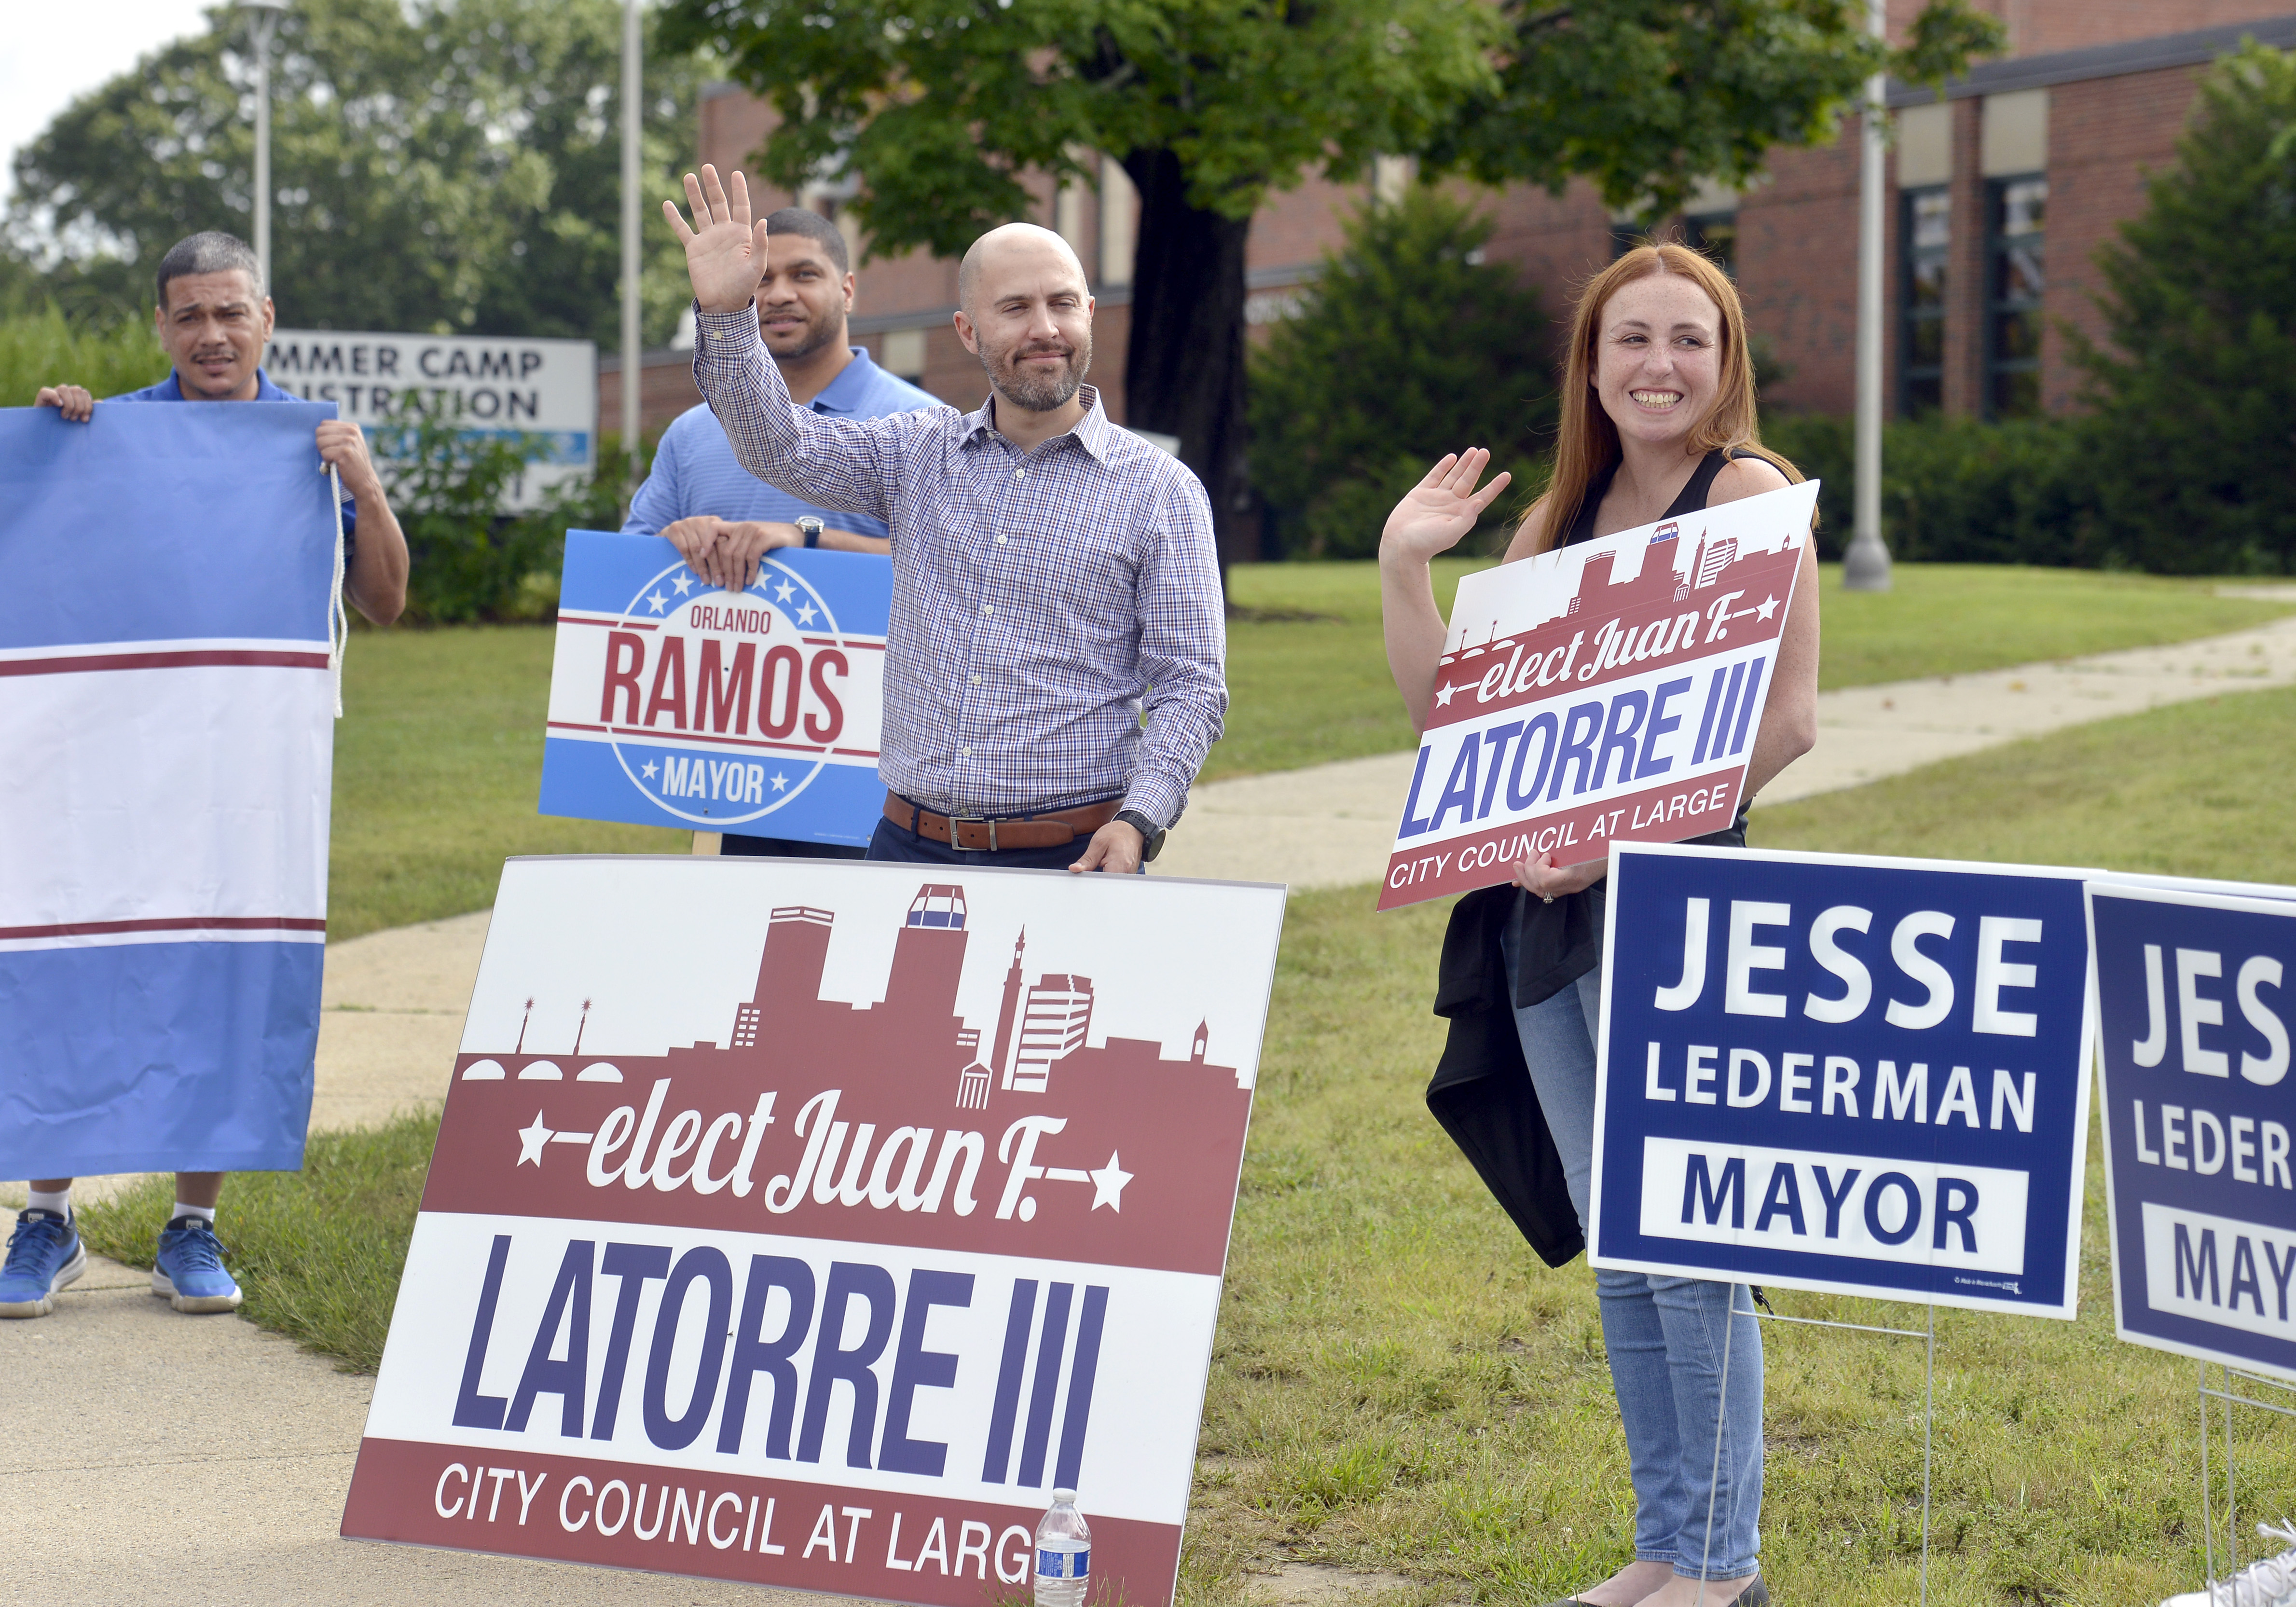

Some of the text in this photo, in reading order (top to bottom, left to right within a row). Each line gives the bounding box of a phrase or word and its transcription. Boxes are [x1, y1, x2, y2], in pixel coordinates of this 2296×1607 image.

[268, 344, 542, 381] MMER CAMP
[303, 385, 536, 420] ISTRATION
[690, 605, 771, 635] ORLANDO
[1477, 589, 1746, 703] elect Juan F.
[601, 632, 848, 743] RAMOS
[662, 756, 764, 804] MAYOR
[1397, 657, 1766, 840] LATORRE III
[1390, 783, 1729, 889] CITY COUNCIL AT LARGE
[1654, 897, 2043, 1037] JESSE
[2133, 945, 2290, 1085] JES
[1645, 1042, 2036, 1133] LEDERMAN
[587, 1078, 1068, 1222] elect Juan F.
[2134, 1100, 2292, 1189] LEDER
[1681, 1154, 1979, 1253] MAYOR
[2174, 1222, 2296, 1321] MAY
[451, 1235, 1110, 1493] LATORRE III
[435, 1463, 1031, 1585] CITY COUNCIL AT LARG
